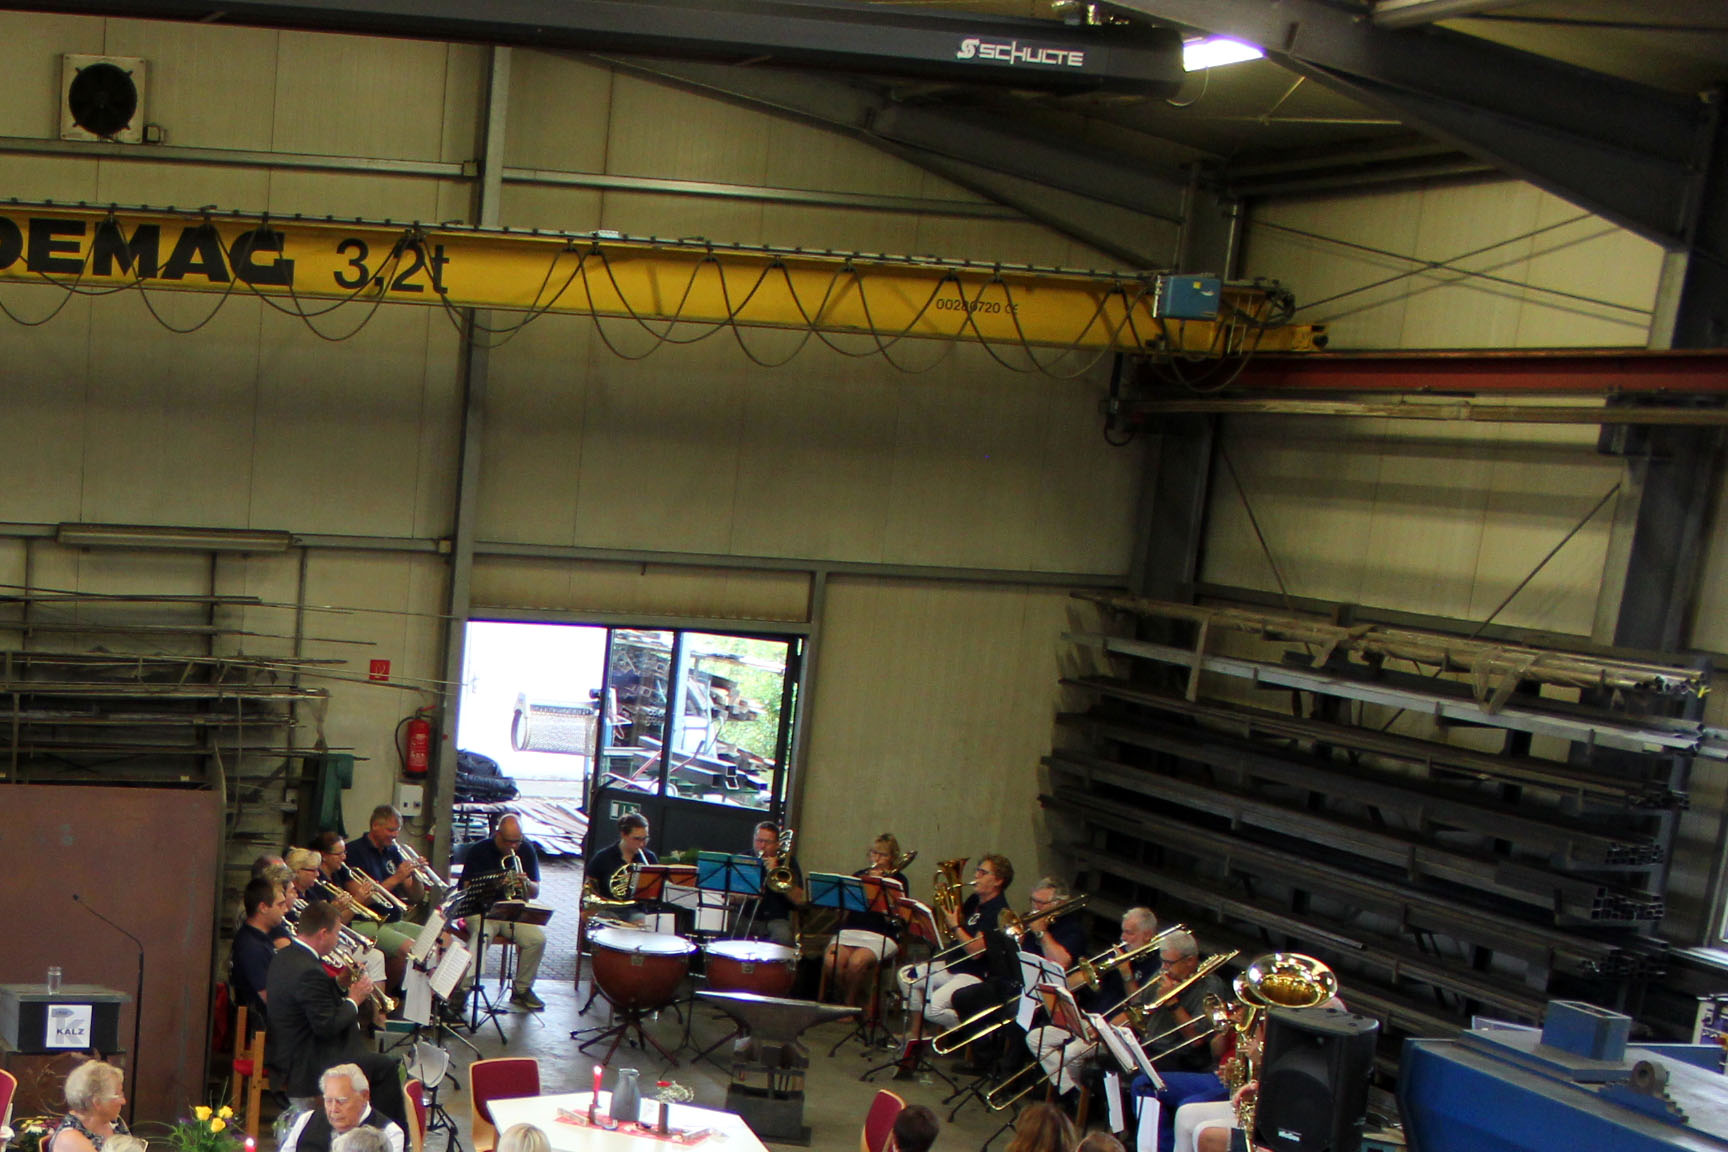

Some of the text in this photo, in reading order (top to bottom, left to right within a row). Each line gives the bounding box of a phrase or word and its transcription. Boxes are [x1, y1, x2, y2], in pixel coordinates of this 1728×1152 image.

[979, 40, 1084, 67] SCHULTE
[333, 237, 449, 297] 3,2t
[56, 1027, 85, 1036] KALZ
